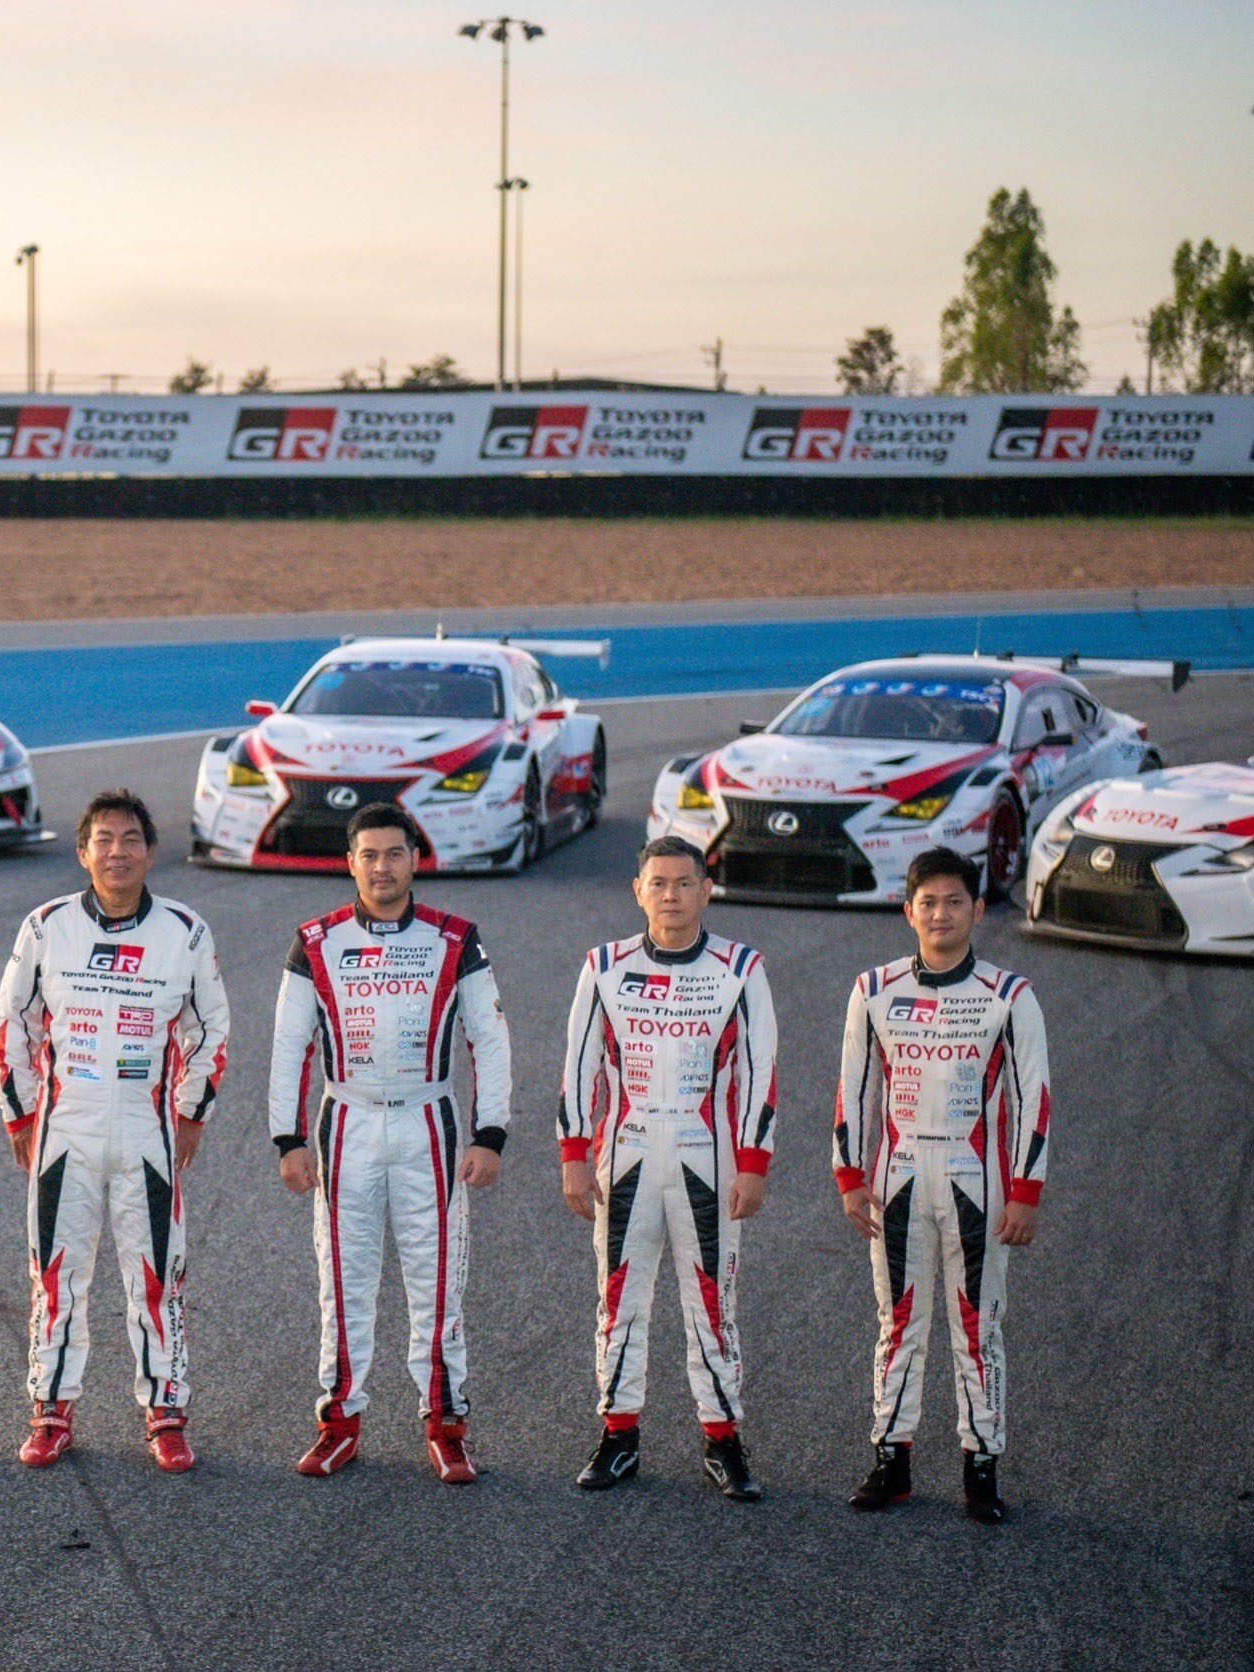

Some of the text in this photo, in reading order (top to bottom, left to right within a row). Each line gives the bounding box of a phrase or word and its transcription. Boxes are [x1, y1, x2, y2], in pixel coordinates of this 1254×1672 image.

[77, 407, 191, 425] TOYOTA
[343, 409, 456, 425] TOYOTA
[596, 406, 707, 424] TOYOTA
[858, 410, 968, 426] TOYOTA
[1107, 409, 1215, 426] TOYOTA
[74, 426, 178, 442] GAZOO
[340, 428, 443, 443] GAZOO
[481, 423, 582, 459] GR
[593, 426, 693, 442] GAZOO
[854, 429, 956, 444] GAZOO
[1102, 428, 1203, 444] GAZOO
[229, 425, 330, 461] GR
[745, 425, 845, 461] GR
[991, 425, 1093, 461] GR
[70, 444, 171, 463] Racing
[336, 446, 438, 464] Racing
[588, 444, 687, 463] Racing
[850, 446, 950, 465] Racing
[1097, 445, 1196, 465] Racing
[1105, 808, 1179, 831] TOYOTA
[303, 924, 323, 937] 12
[88, 951, 141, 973] GR
[340, 954, 381, 968] GR
[61, 971, 167, 987] TOYOTA GAZOO Racing
[339, 970, 435, 982] Team Thailand
[100, 986, 153, 998] Thailand
[345, 980, 429, 998] TOYOTA
[619, 981, 668, 1000] GR
[65, 1007, 103, 1018] TOYOTA
[120, 1010, 153, 1021] TRD
[345, 1005, 374, 1015] arto
[616, 1004, 723, 1017] Team Thailand
[888, 1005, 936, 1023] GR
[70, 1021, 98, 1033] arto
[626, 1018, 712, 1037] TOYOTA
[938, 1017, 981, 1025] Racing
[119, 1025, 152, 1036] MOTUL
[888, 1028, 988, 1040] Team Thailand
[625, 1042, 653, 1053] arto
[894, 1043, 981, 1061] TOYOTA
[894, 1065, 922, 1076] arto
[894, 1083, 919, 1091] MOTUL
[624, 1123, 646, 1133] KELA
[892, 1152, 915, 1161] KELA
